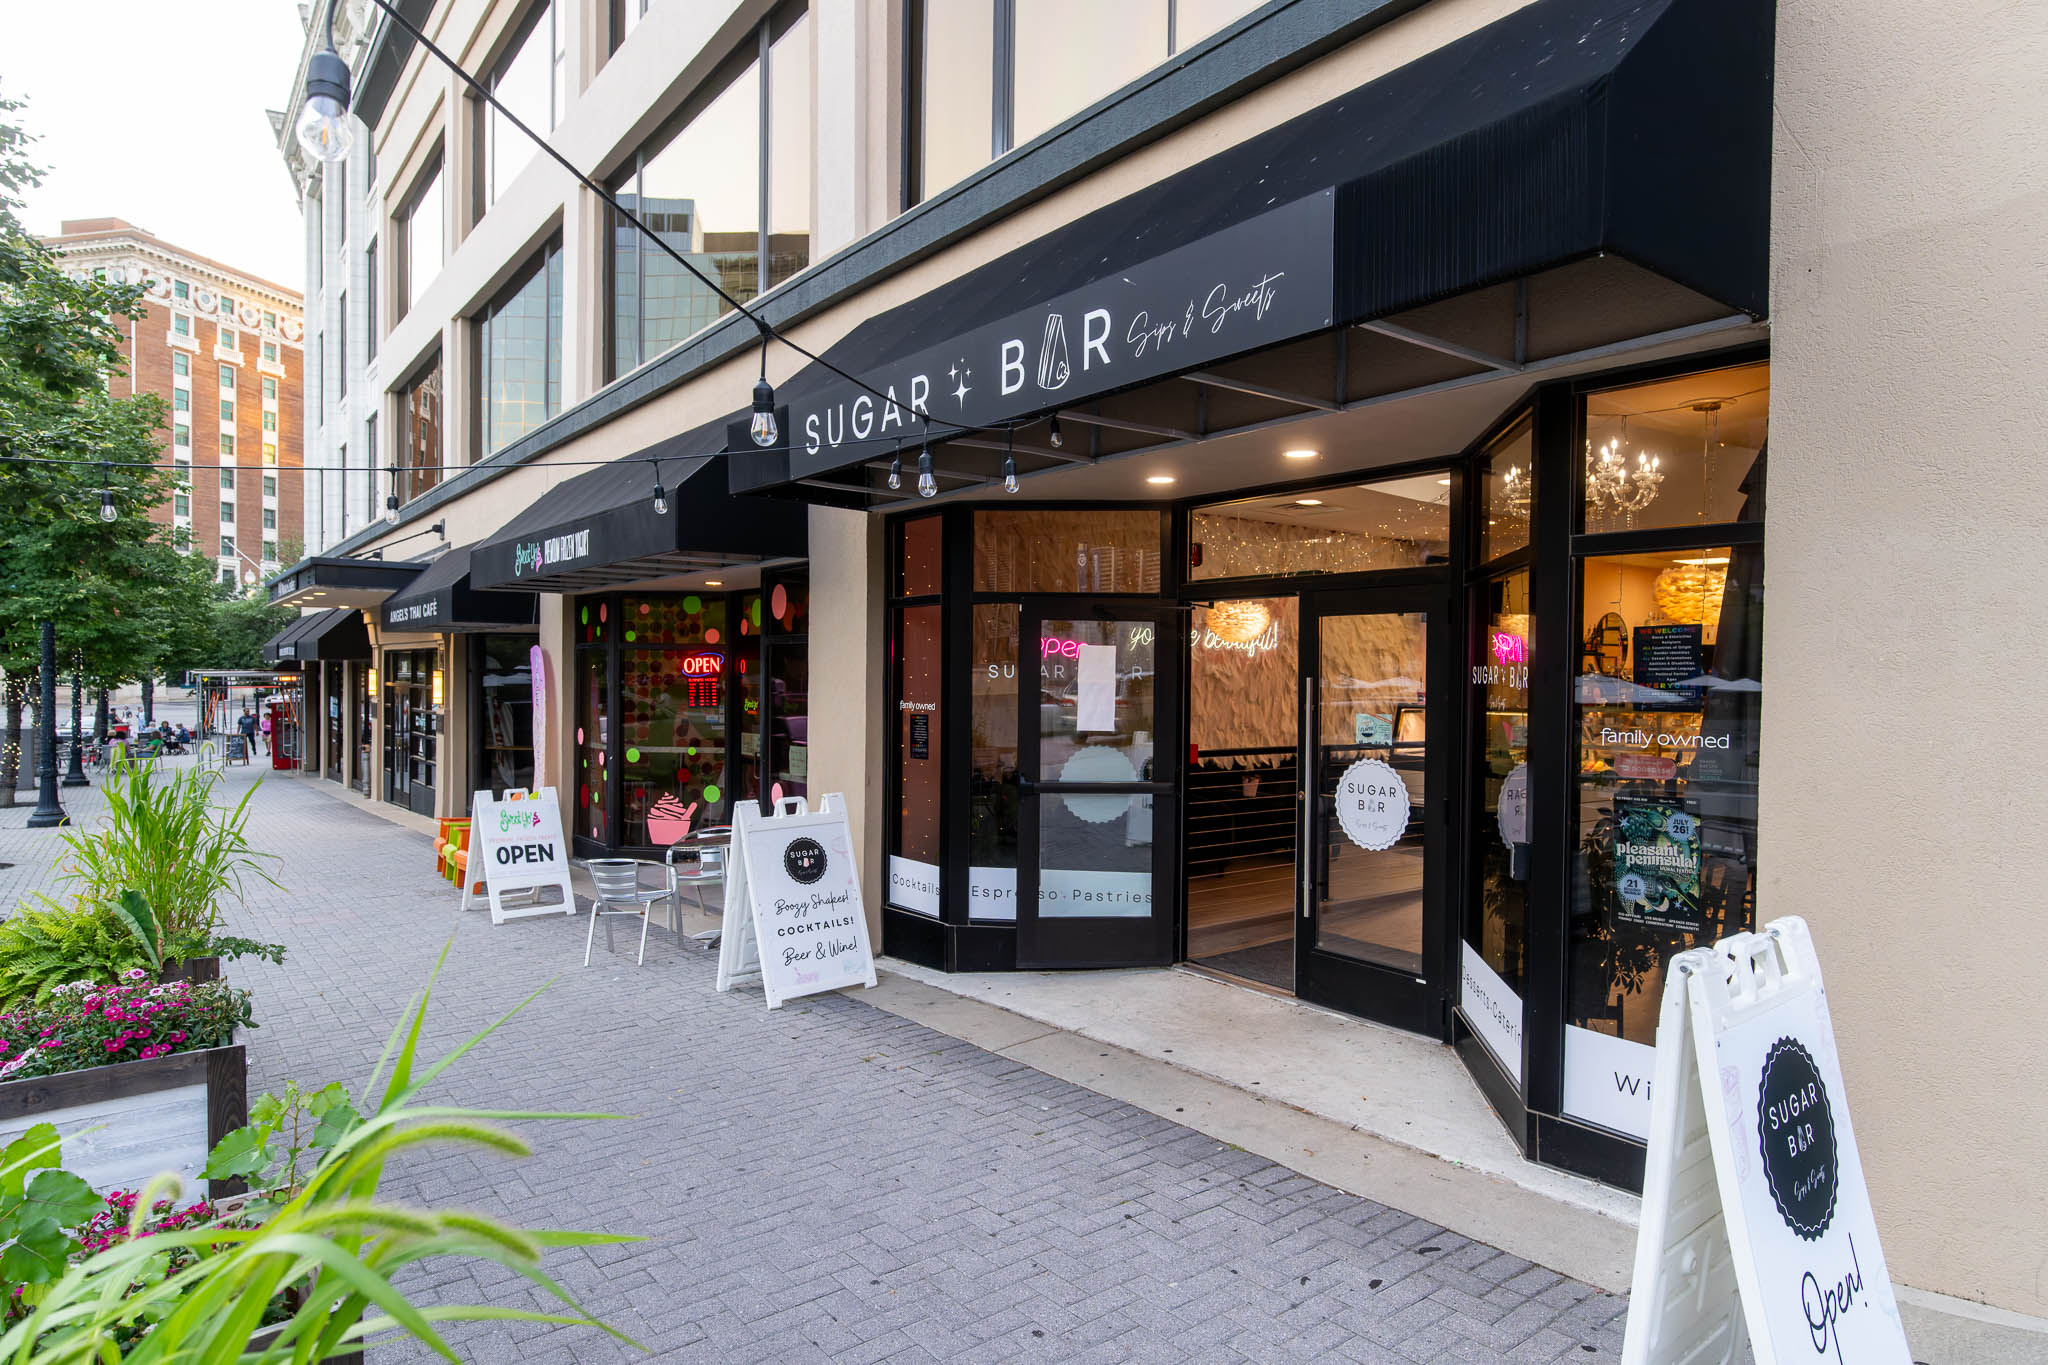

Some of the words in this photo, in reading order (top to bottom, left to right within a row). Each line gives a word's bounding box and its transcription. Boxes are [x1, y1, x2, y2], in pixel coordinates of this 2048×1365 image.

[1126, 311, 1176, 358] Sips
[1202, 272, 1285, 334] Sweets
[805, 374, 930, 455] SUGAR
[390, 608, 408, 623] ANGEL'S
[409, 605, 421, 619] THAI
[423, 597, 437, 617] CAFÉ
[683, 656, 720, 673] OPEN
[1472, 665, 1498, 685] SUGAR
[900, 700, 914, 711] family
[916, 702, 935, 711] owned
[1600, 728, 1653, 748] family
[1657, 734, 1730, 749] owned
[1348, 783, 1397, 798] SUGAR
[1673, 825, 1689, 834] 26!
[496, 843, 554, 865] OPEN
[790, 848, 819, 859] SUGAR
[1616, 841, 1679, 857] pleasant
[797, 858, 815, 868] BR
[1626, 854, 1697, 869] peninsula!
[892, 873, 941, 896] Cocktails
[1627, 879, 1638, 888] 21
[774, 899, 810, 919] Boozy
[811, 890, 849, 911] Shakes!
[972, 885, 1057, 901] Esprso
[1072, 889, 1152, 904] Pastries
[777, 917, 854, 937] COCKTAILS!
[782, 948, 811, 966] Beer
[816, 943, 826, 960] &
[829, 936, 858, 958] Wine!
[1769, 1082, 1818, 1130] SUGAR
[1801, 1231, 1868, 1365] Open!
